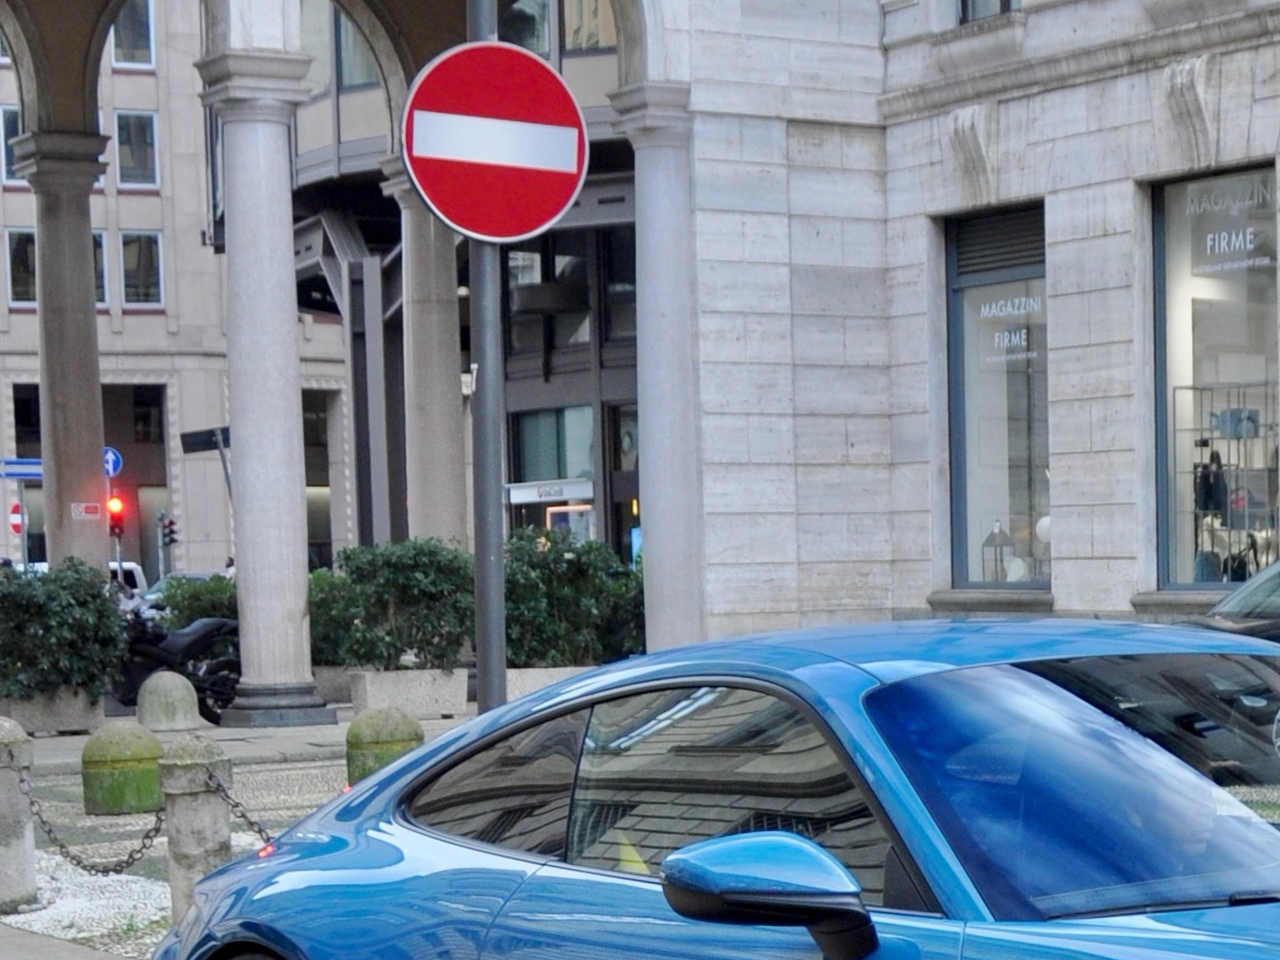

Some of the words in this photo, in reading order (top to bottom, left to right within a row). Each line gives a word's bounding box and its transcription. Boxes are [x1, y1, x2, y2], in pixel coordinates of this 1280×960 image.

[1206, 227, 1255, 255] FIRME
[980, 296, 1042, 318] MAGAZZINI
[994, 329, 1028, 349] FIRME
